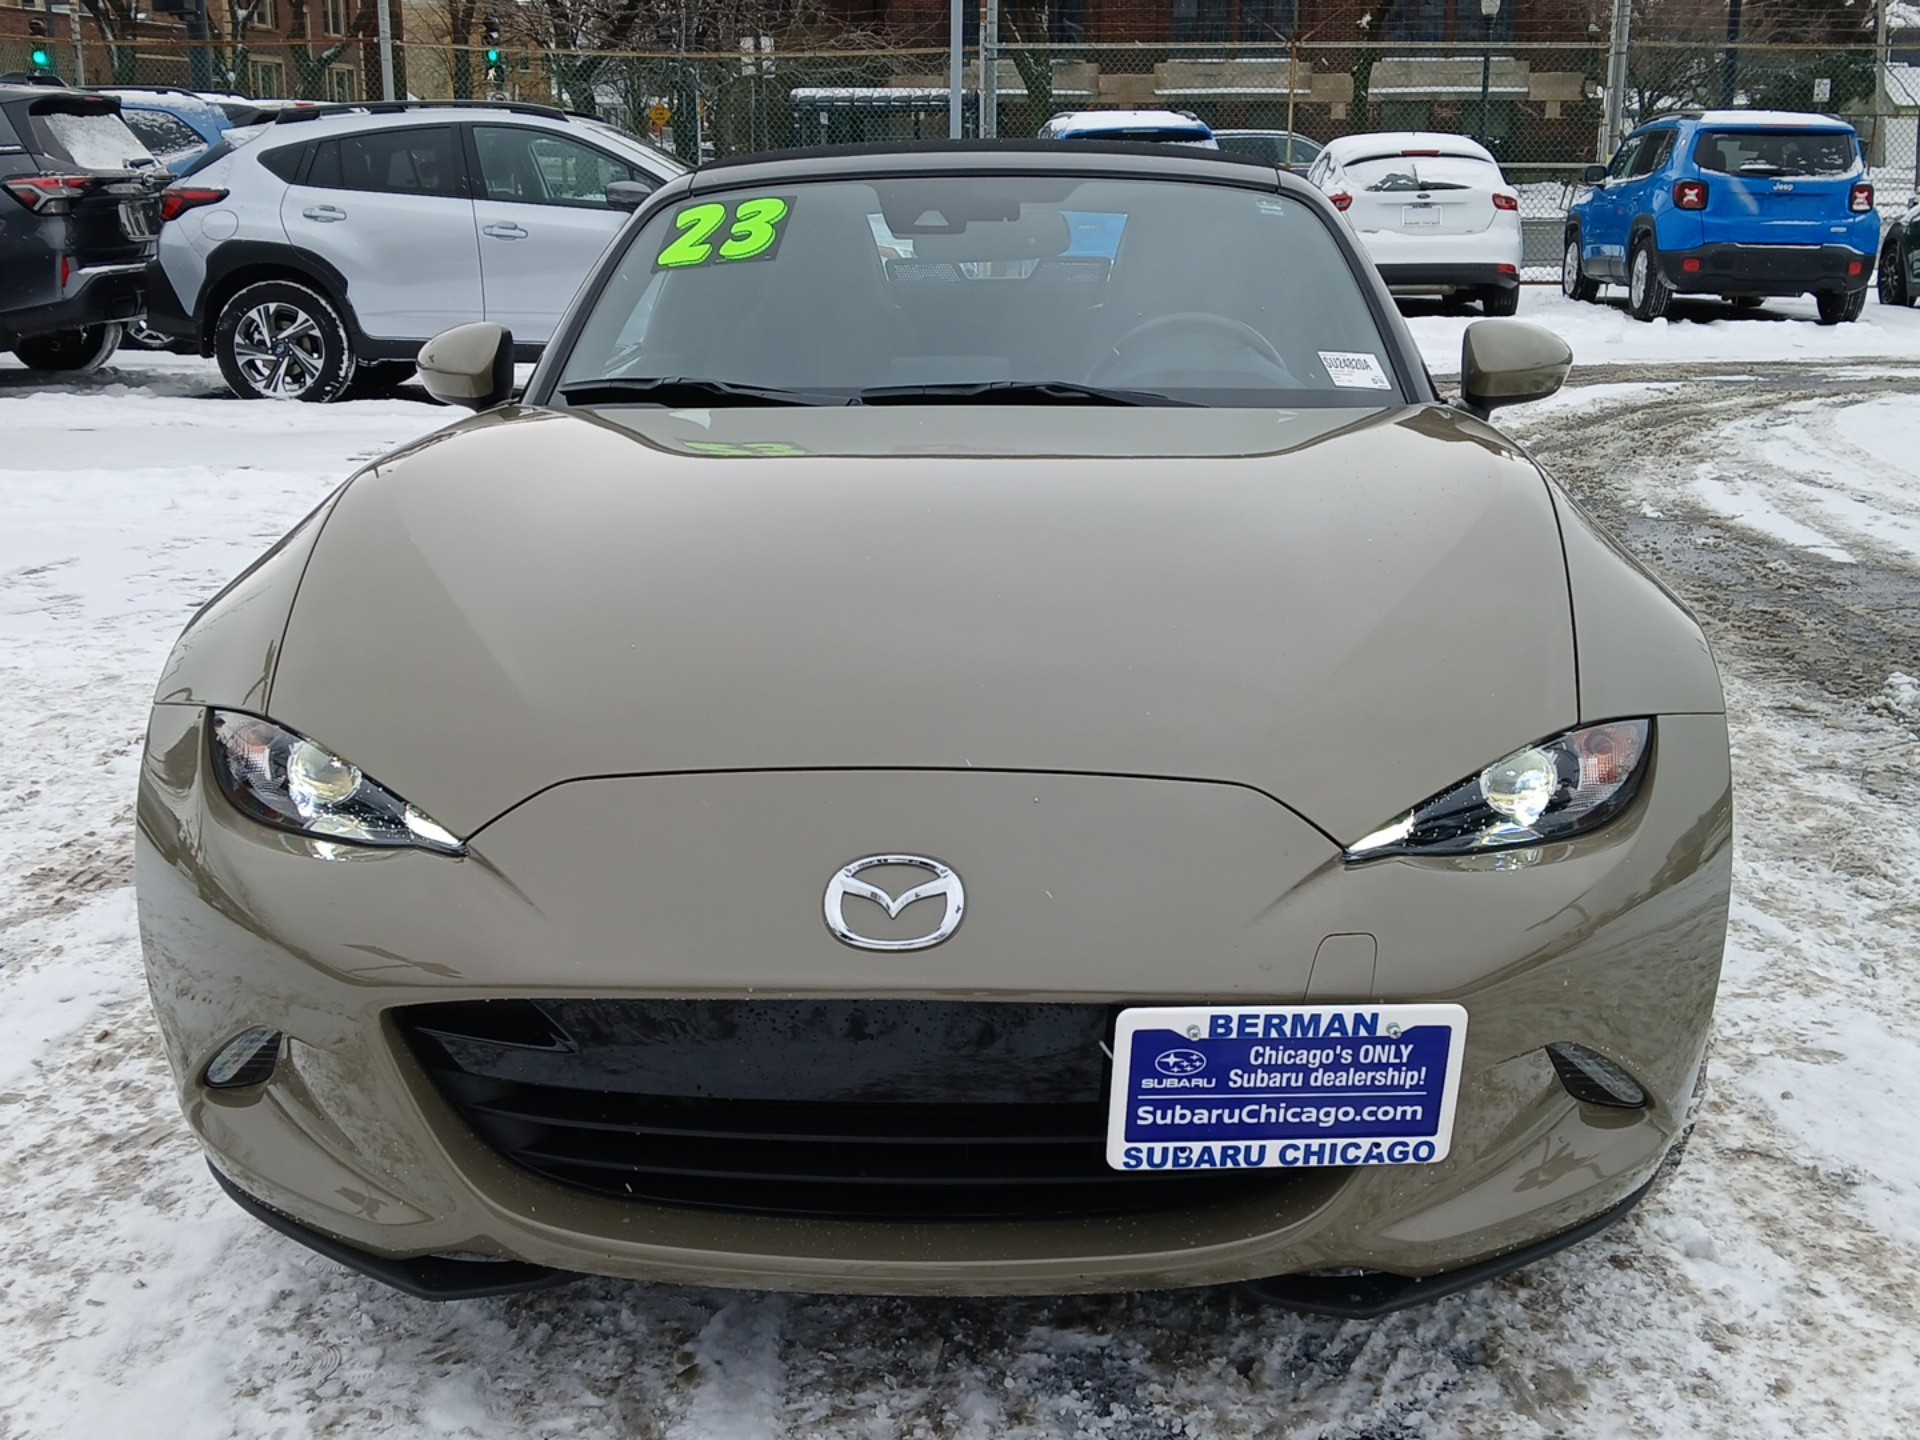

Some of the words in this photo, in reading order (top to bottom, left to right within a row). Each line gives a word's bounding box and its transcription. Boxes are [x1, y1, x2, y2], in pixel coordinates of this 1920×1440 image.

[1772, 182, 1794, 192] Jeep
[656, 197, 788, 268] 23
[1209, 1012, 1380, 1038] BERMAN
[1249, 1045, 1353, 1068] Chicago's
[1359, 1044, 1414, 1063] ONLY
[1141, 1077, 1216, 1089] SUBARU
[1228, 1068, 1304, 1088] Subaru
[1309, 1066, 1426, 1089] dealership!
[1136, 1103, 1423, 1128] SubaruChicago.com
[1122, 1144, 1266, 1169] SUBARU
[1278, 1140, 1436, 1166] CHICAGO
